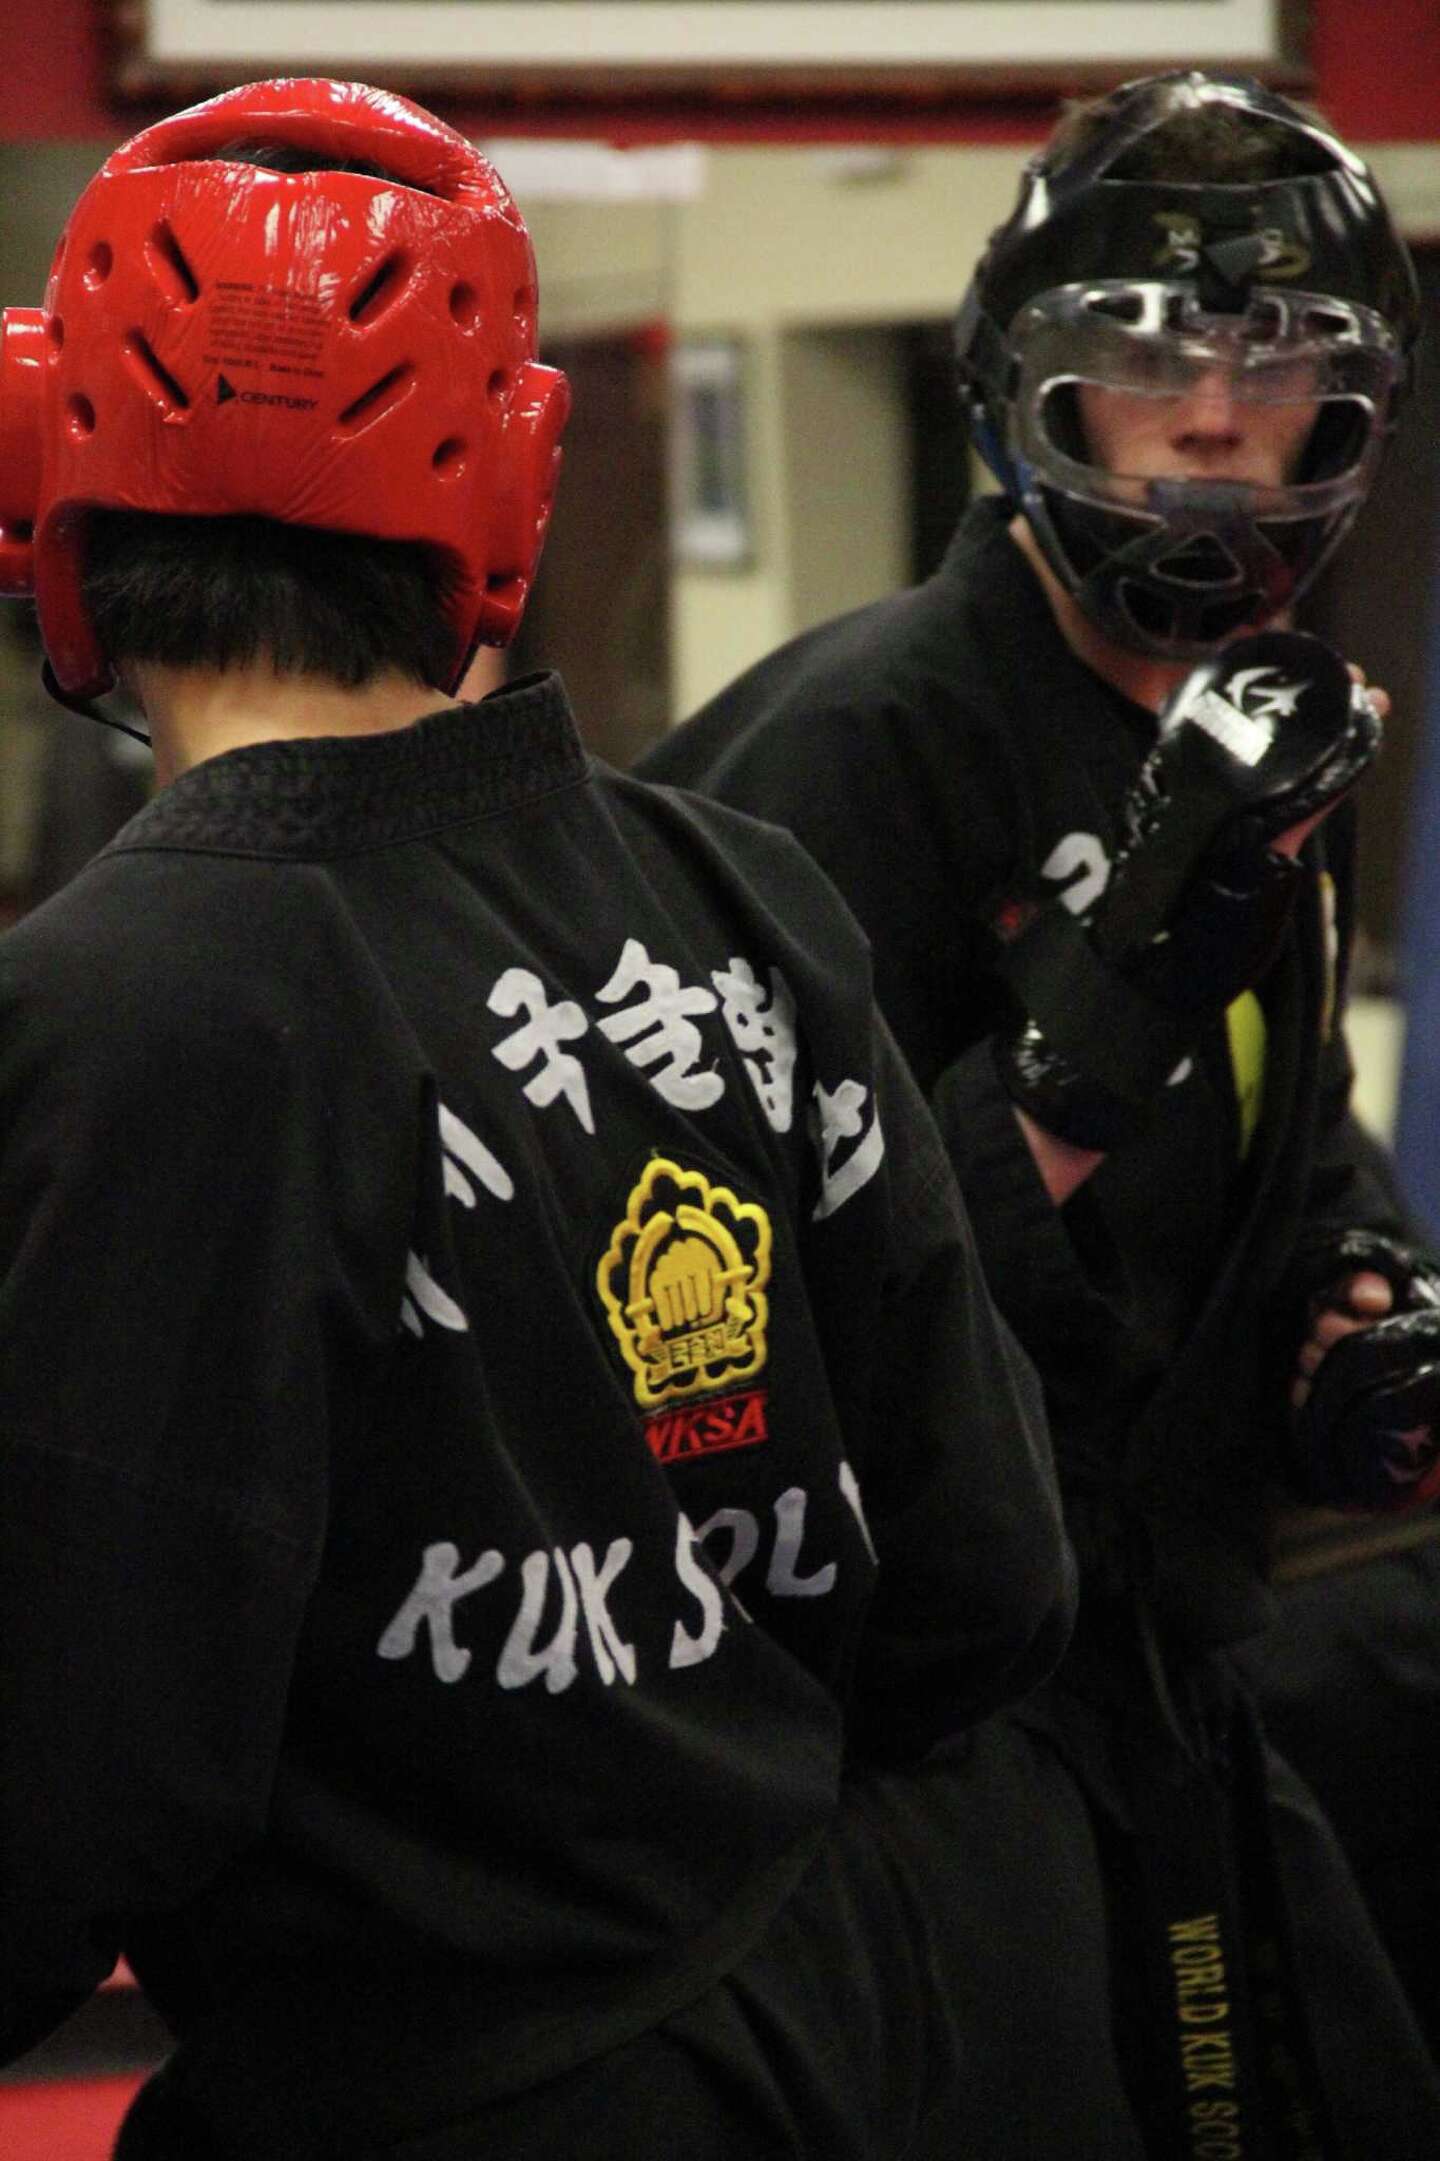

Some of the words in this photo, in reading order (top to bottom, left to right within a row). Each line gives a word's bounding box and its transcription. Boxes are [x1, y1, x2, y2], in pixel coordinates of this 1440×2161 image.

[239, 391, 319, 410] CENTURY
[376, 1537, 637, 1694] KUK
[1167, 1915, 1230, 2024] WORLD
[1178, 2031, 1236, 2092] KUK
